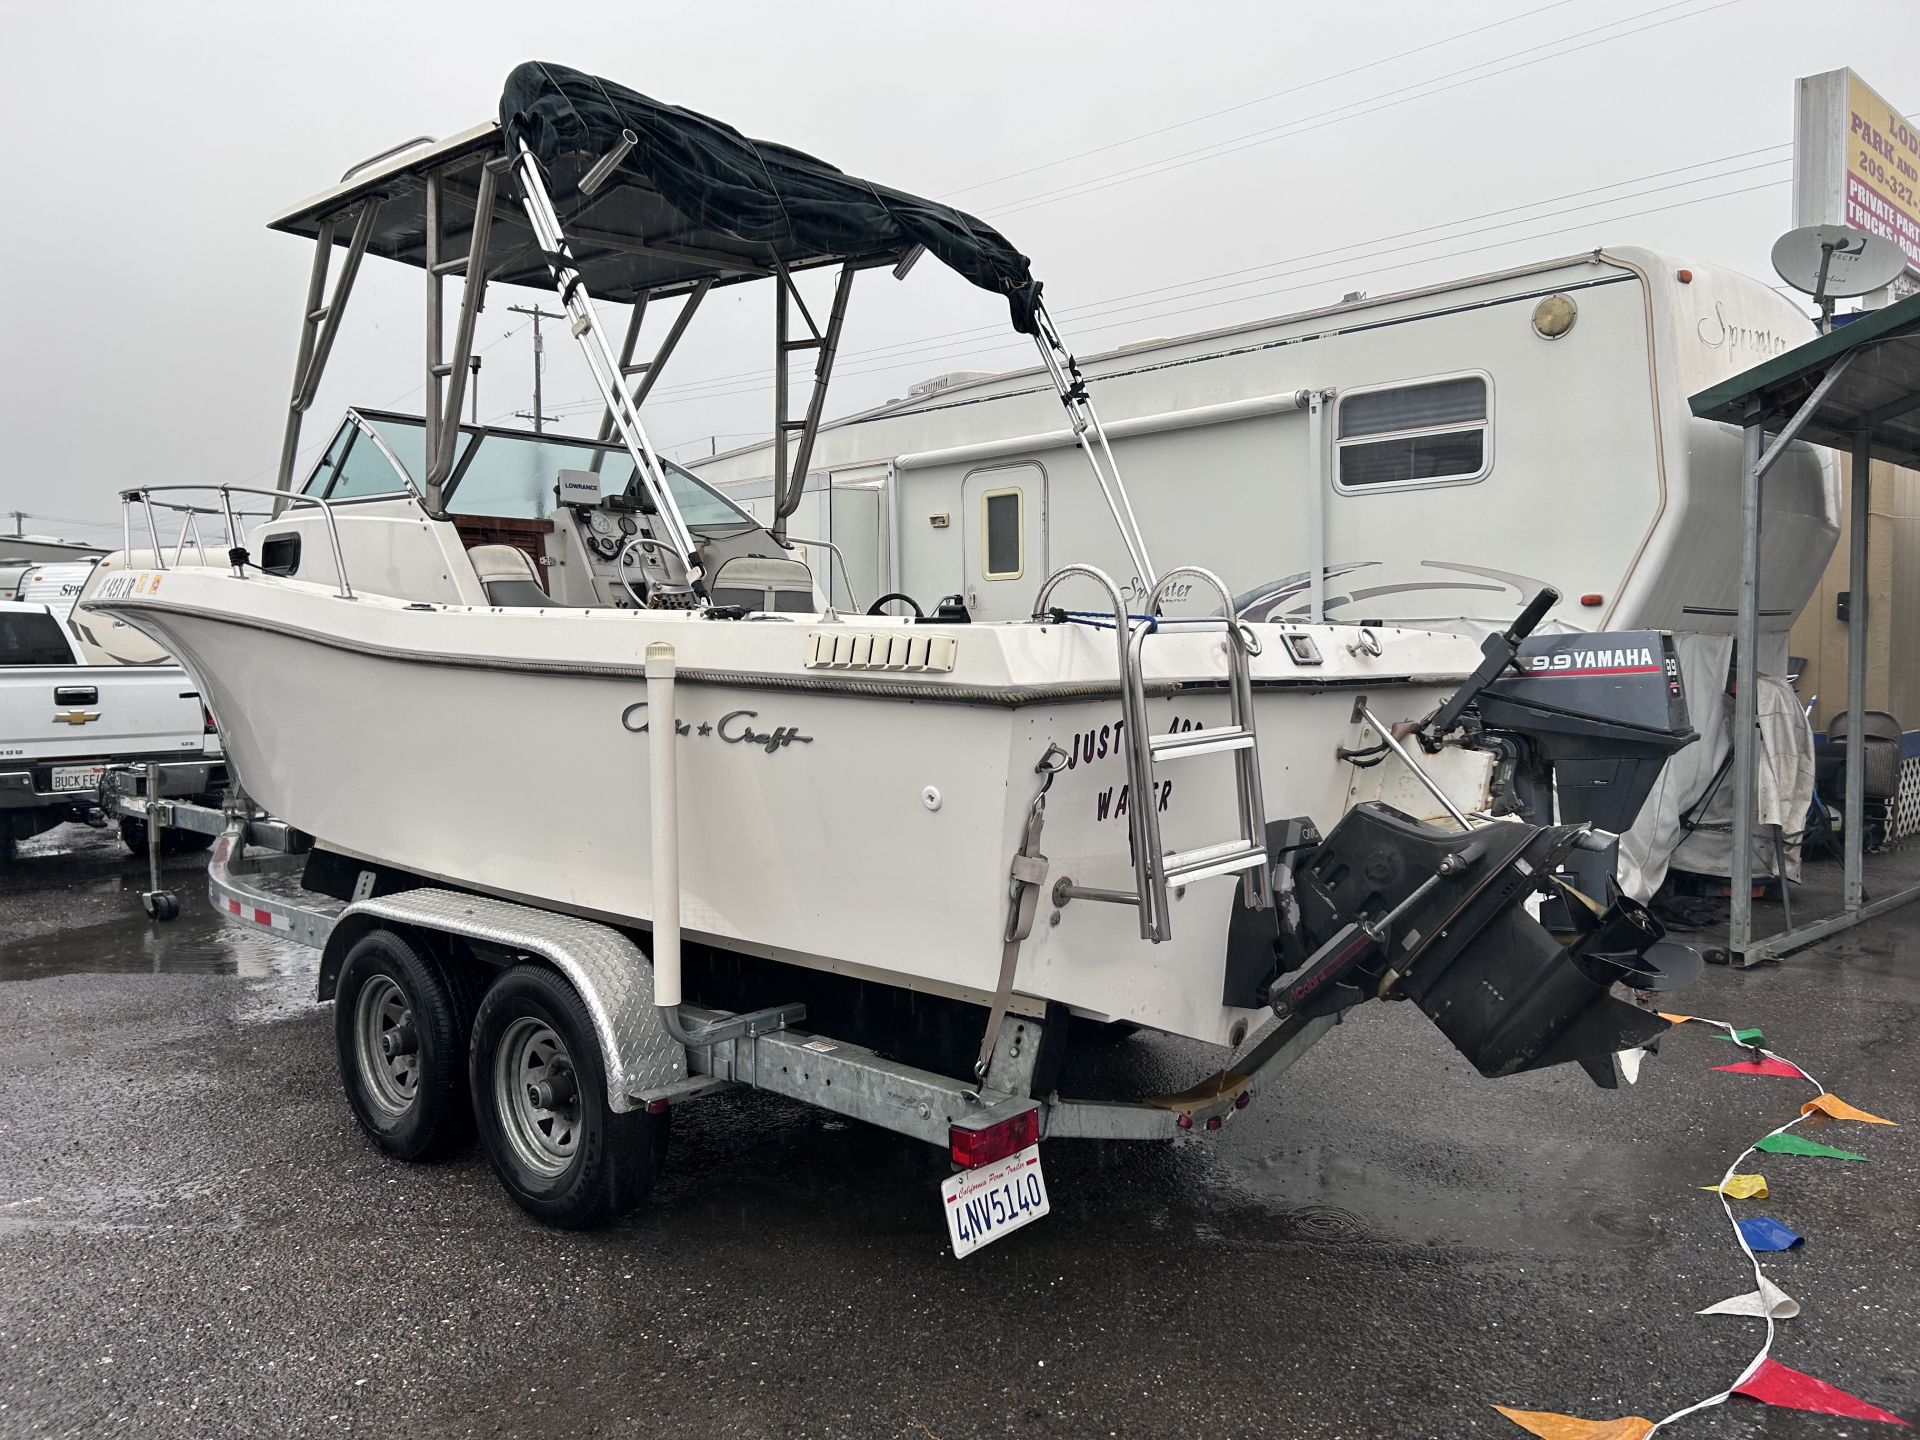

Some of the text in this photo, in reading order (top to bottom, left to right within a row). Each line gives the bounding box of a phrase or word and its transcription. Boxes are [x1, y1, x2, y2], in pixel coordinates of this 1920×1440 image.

[1851, 111, 1918, 183] PARK AND
[1889, 114, 1920, 160] LOD
[1859, 150, 1920, 214] 209-327-
[1848, 199, 1892, 241] TRUCKS
[1849, 178, 1920, 243] PRIVATE PART
[565, 482, 599, 491] LOWRANCE
[60, 583, 84, 596] SPR
[1574, 648, 1653, 669] YAMAHA
[717, 710, 813, 753] Craft
[1068, 720, 1124, 770] JUST
[54, 775, 81, 788] BUCK
[1097, 780, 1172, 821] WAR
[1303, 827, 1320, 840] OMC
[958, 1162, 1025, 1199] California Perm Trailer
[956, 1173, 1042, 1242] 4NV5140
